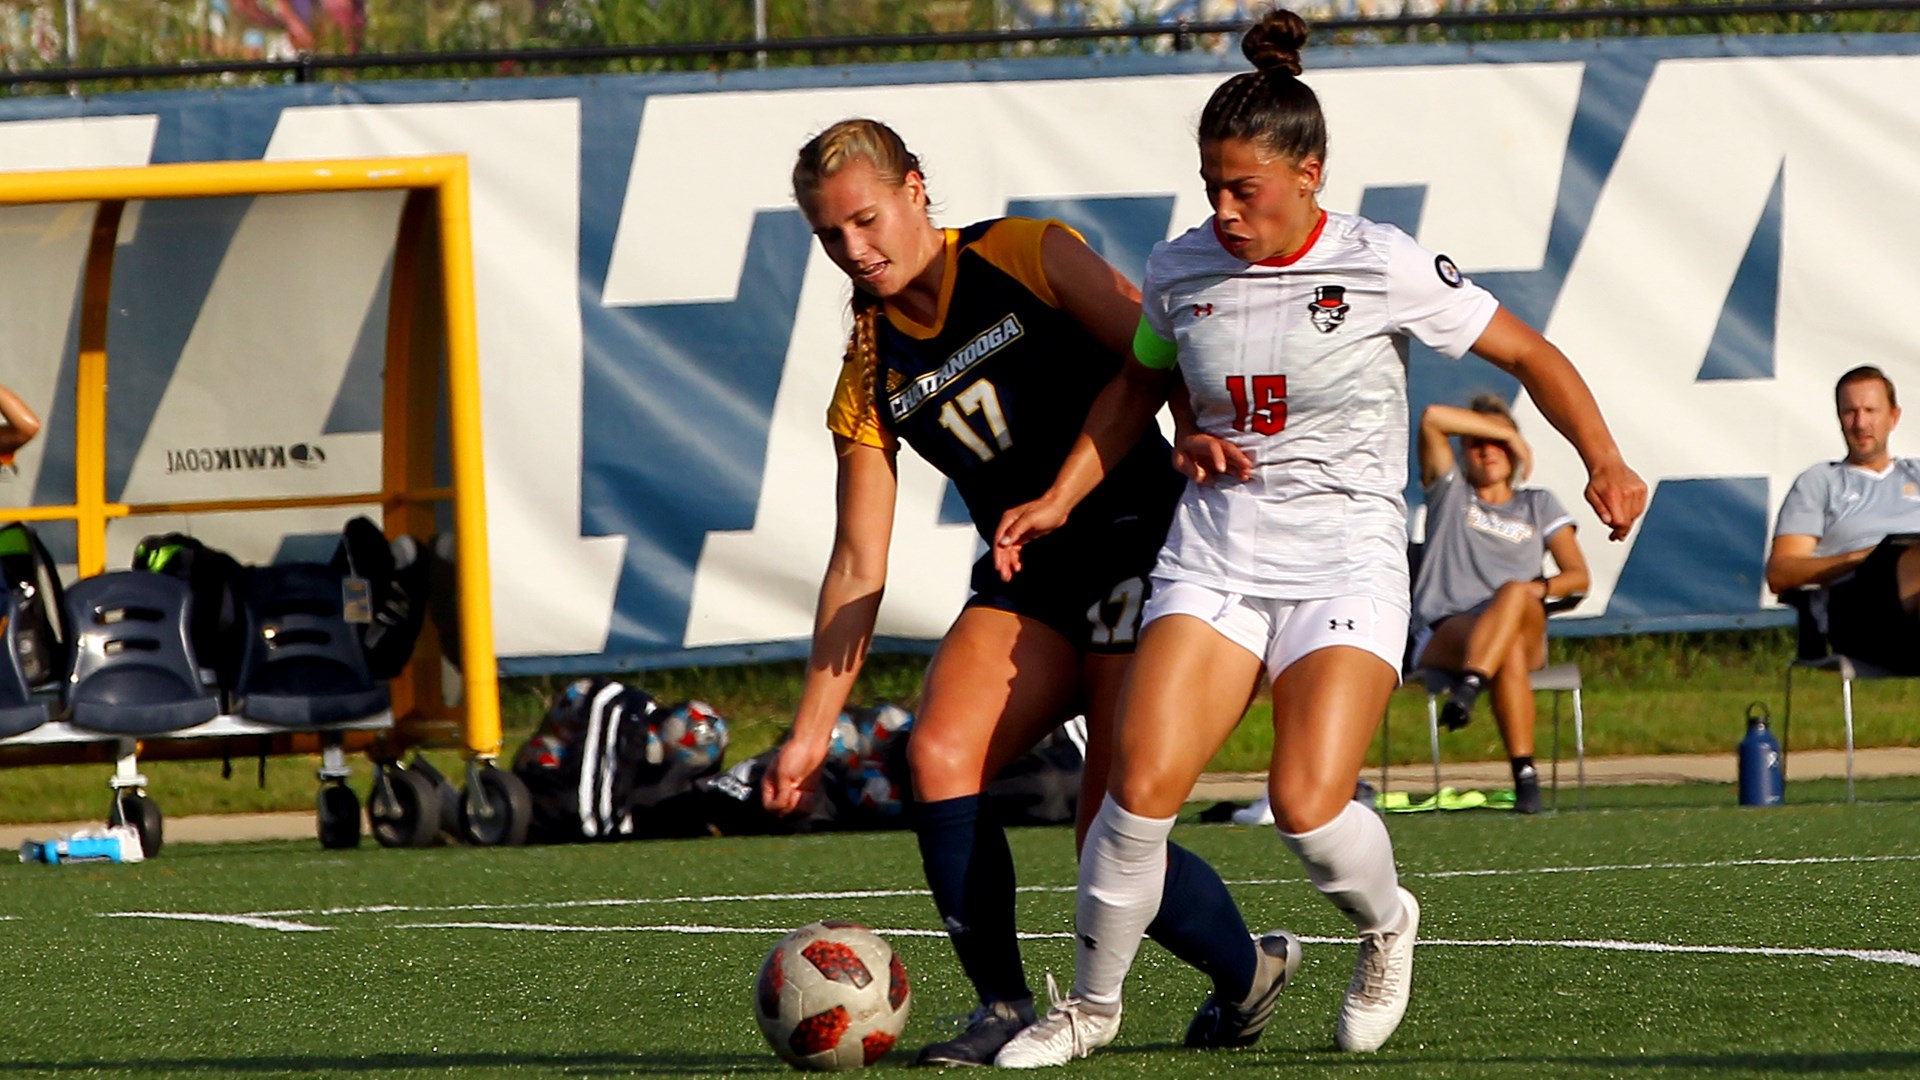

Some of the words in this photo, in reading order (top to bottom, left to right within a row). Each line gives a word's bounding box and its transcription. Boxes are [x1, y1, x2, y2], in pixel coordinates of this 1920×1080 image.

[888, 317, 1020, 420] CHATTANOOGA
[1225, 374, 1288, 436] 15
[938, 377, 1013, 462] 17
[1086, 576, 1144, 644] 17
